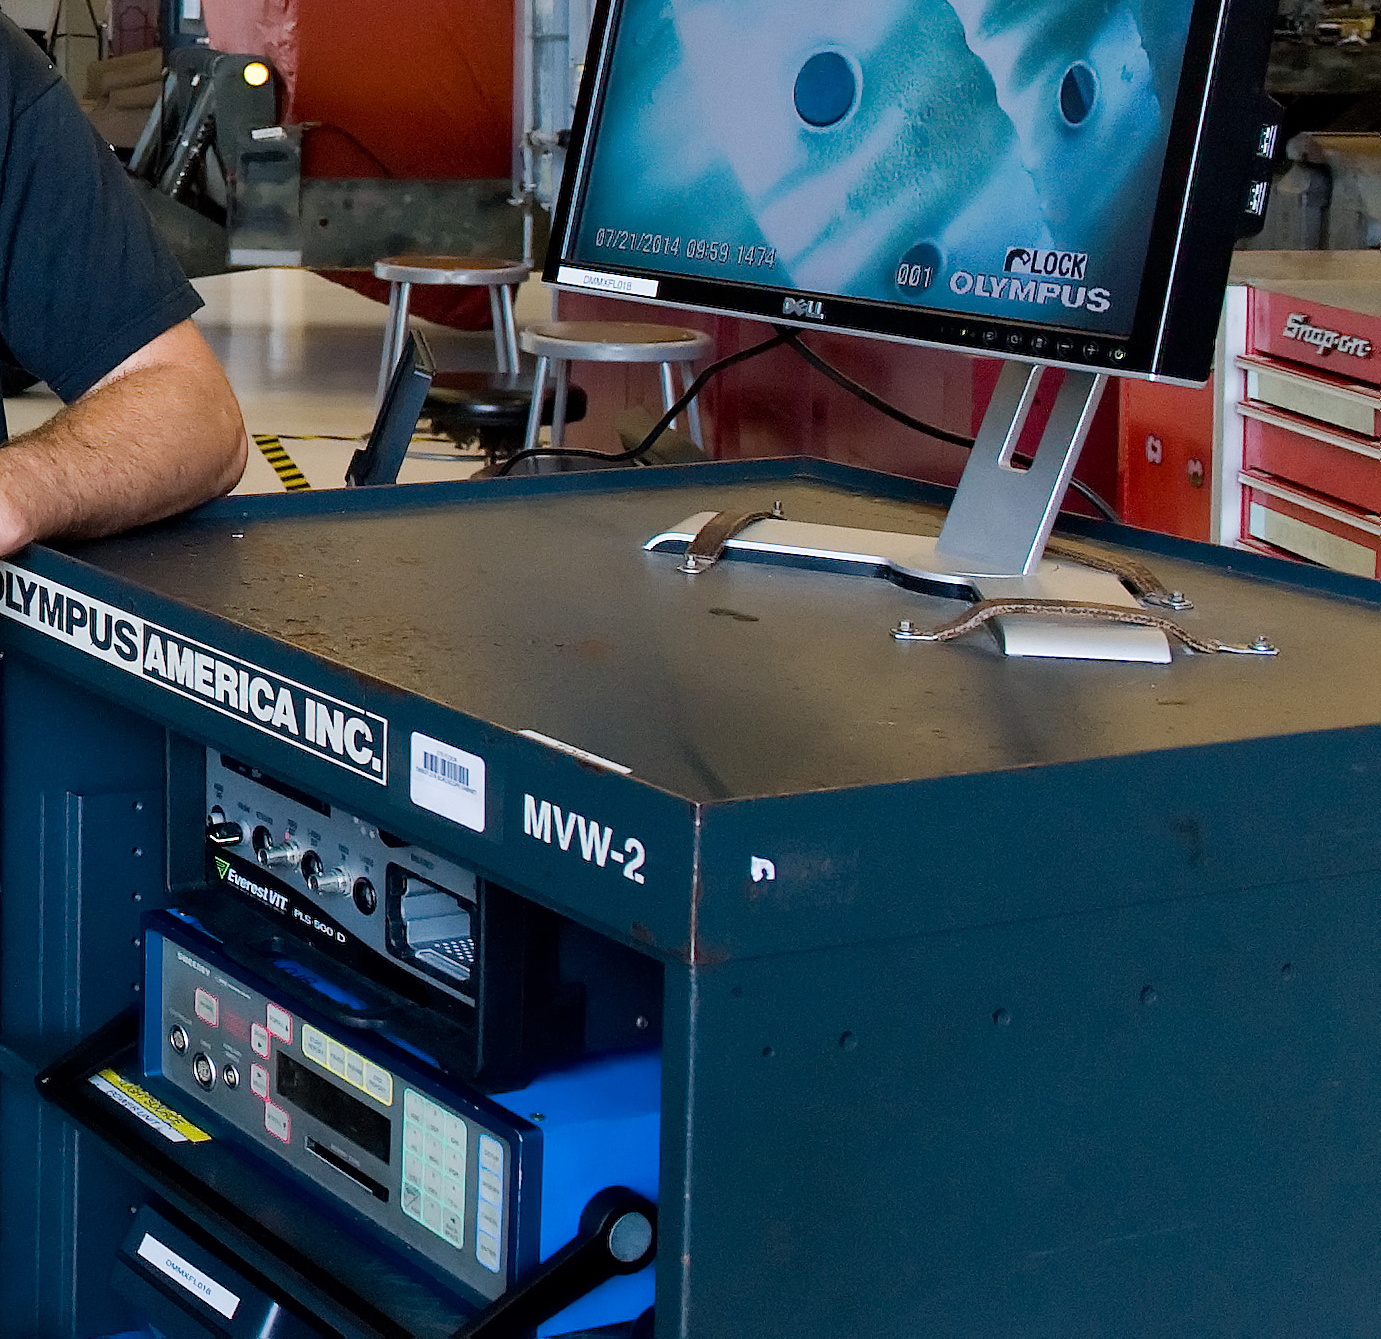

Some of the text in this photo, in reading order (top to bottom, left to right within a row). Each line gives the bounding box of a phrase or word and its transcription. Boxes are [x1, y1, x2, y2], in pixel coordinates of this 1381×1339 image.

[595, 227, 777, 269] 07/21/2014 09:59 1474
[1030, 249, 1087, 280] LOCK
[897, 262, 933, 288] 001
[949, 270, 1111, 314] OLYMPUS
[782, 296, 825, 320] DELL
[1282, 312, 1371, 358] Snap-on
[144, 633, 299, 737] AMERICA
[304, 696, 381, 773] INC.
[523, 792, 645, 885] MVW-2
[293, 907, 312, 926] PLS
